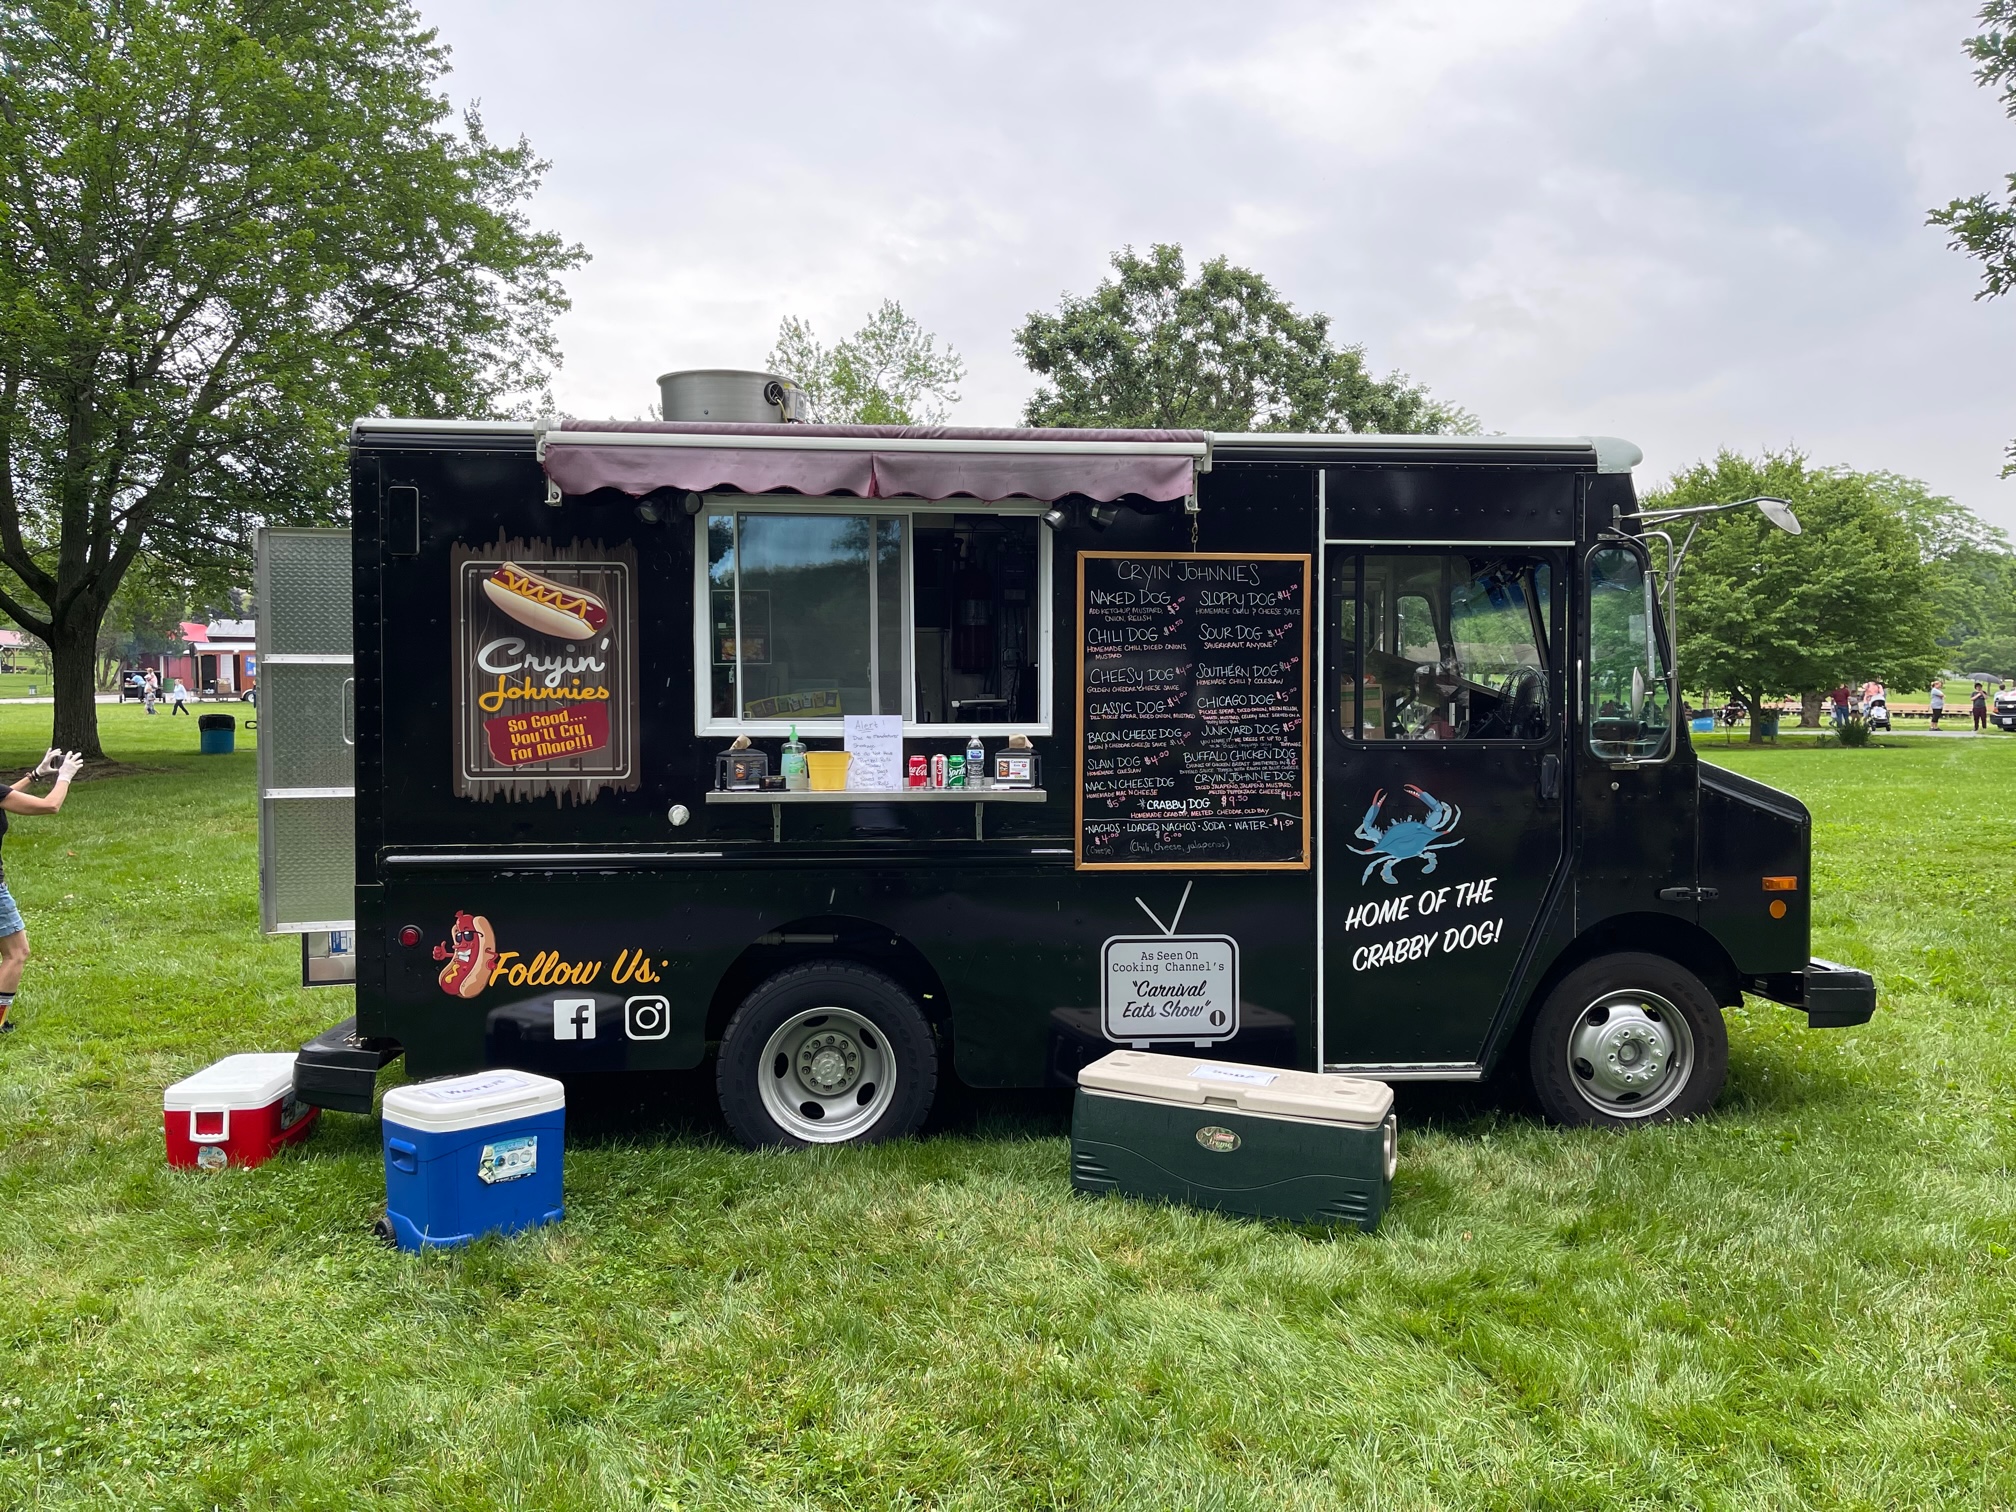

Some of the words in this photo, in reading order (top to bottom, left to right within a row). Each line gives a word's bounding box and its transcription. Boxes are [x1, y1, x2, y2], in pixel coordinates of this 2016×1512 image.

[1177, 561, 1260, 586] JOHNNIES
[1090, 589, 1136, 605] NAKED
[1139, 589, 1171, 605] DOG
[1199, 590, 1245, 612] SLOPPY
[1247, 592, 1277, 606] DOG
[1277, 584, 1298, 600] $4.50
[1258, 607, 1281, 615] CHEESE
[1088, 627, 1123, 645] CHILI
[1126, 627, 1159, 641] DOG
[1199, 623, 1234, 640] SOUR
[1235, 625, 1263, 640] DOG
[1266, 622, 1293, 639] $4.00
[1087, 645, 1122, 653] HOMEMADE
[1246, 639, 1278, 650] ANYONE?
[477, 637, 610, 688] Cryin'
[1196, 662, 1250, 678] SOUTHERN
[1252, 664, 1279, 677] DOG
[1090, 666, 1144, 687] CHEESY
[1146, 668, 1174, 681] DOG
[478, 674, 610, 712] Johnnies
[1197, 694, 1247, 708] CHICAGO
[1248, 694, 1275, 705] DOG
[1089, 702, 1132, 715] CLASSIC
[1136, 700, 1166, 714] DOG
[507, 718, 527, 733] So
[1201, 724, 1253, 739] JUNKYARD
[1254, 723, 1280, 735] DOG
[510, 728, 556, 746] You'll
[560, 723, 586, 738] Cry
[1087, 731, 1120, 743] BACON
[1122, 729, 1157, 740] CHEESE
[1158, 728, 1182, 738] DOG
[510, 747, 533, 761] For
[537, 734, 593, 756] More!!!
[1183, 751, 1228, 763] BUFFALO
[1229, 750, 1272, 761] CHICKEN
[1272, 748, 1296, 759] DOG
[1087, 759, 1114, 770] SLAW
[1117, 756, 1141, 767] DOG
[1144, 750, 1169, 766] $4.00
[1272, 771, 1296, 781] DOG
[1085, 780, 1107, 792] MAC
[1118, 777, 1155, 789] CHEESE
[1154, 777, 1175, 787] DOG
[1146, 800, 1187, 813] CRABBY
[1187, 798, 1211, 810] DOG
[1221, 795, 1248, 807] $9.50
[1126, 822, 1159, 832] LOADED
[1161, 821, 1197, 831] NACHOS
[1201, 820, 1226, 831] SODA
[1095, 832, 1119, 845] $4.00
[1345, 894, 1414, 931] HOME
[1418, 886, 1451, 916] OF
[1455, 877, 1498, 908] THE
[1352, 931, 1439, 972] CRABBY
[1443, 917, 1504, 953] DOG!
[1141, 951, 1154, 961] As
[1157, 951, 1183, 961] Seen
[1185, 950, 1199, 960] On
[489, 950, 602, 987] Follow
[611, 948, 669, 985] Us:
[1112, 962, 1159, 974] Cooking
[1165, 961, 1225, 972] Channel's
[1122, 1000, 1156, 1018] Eats
